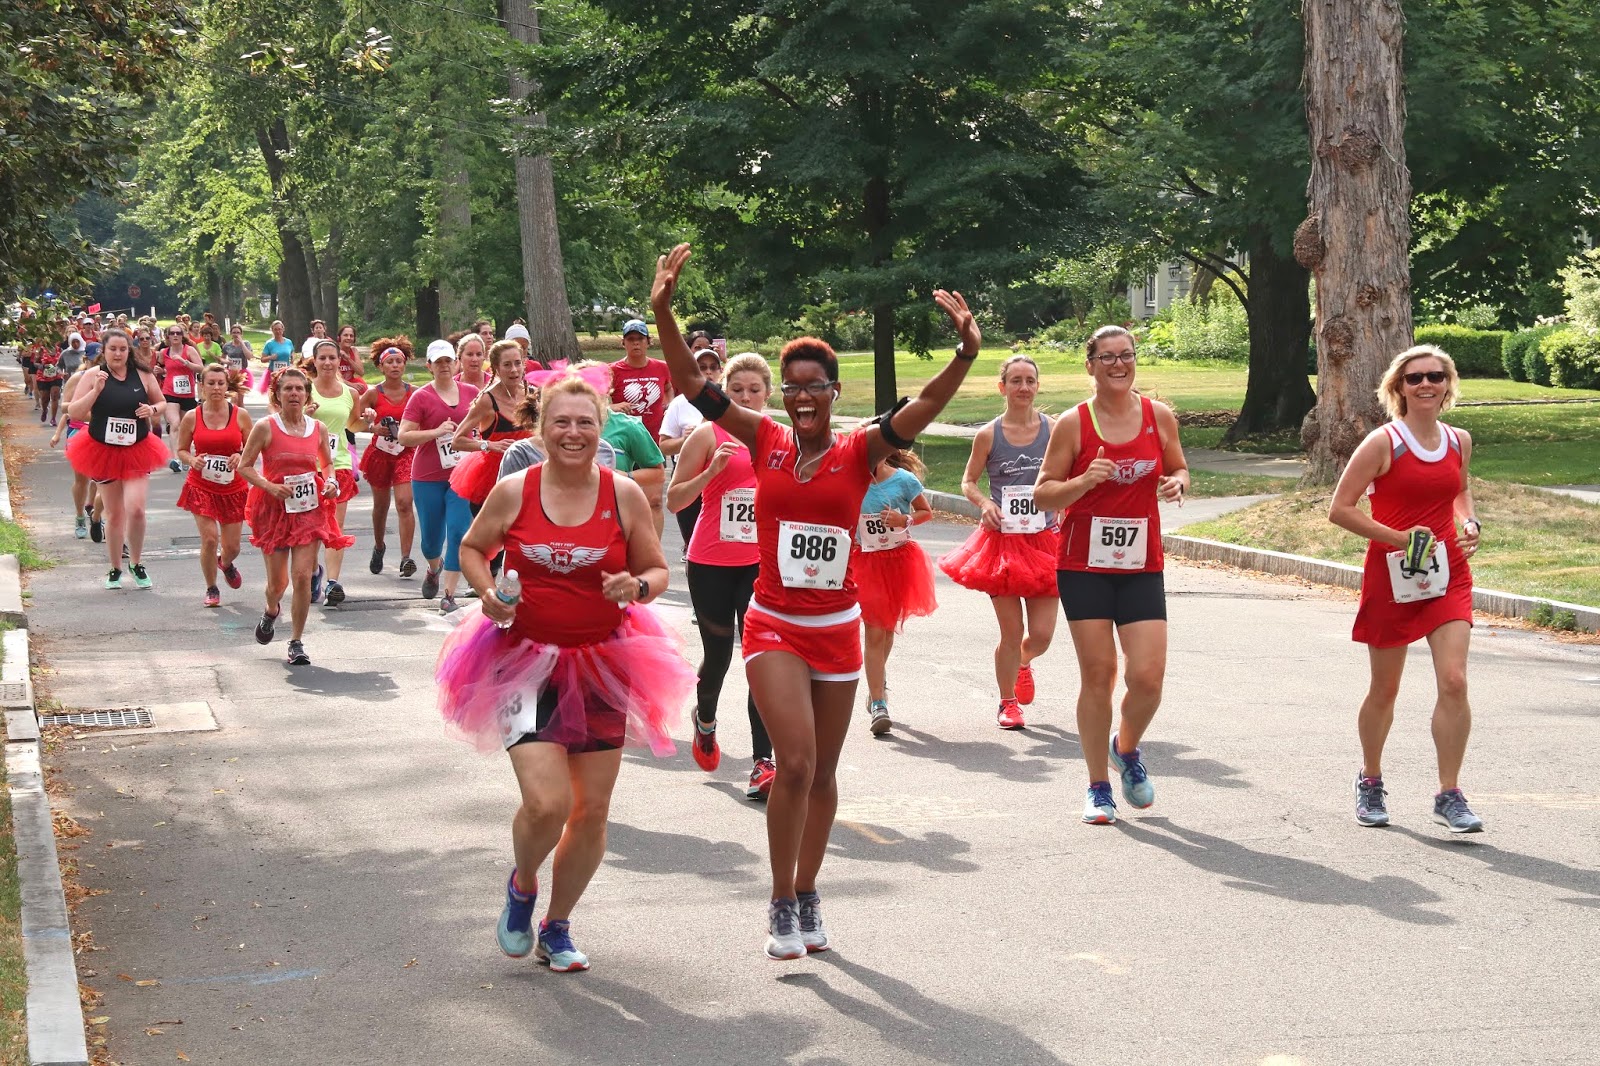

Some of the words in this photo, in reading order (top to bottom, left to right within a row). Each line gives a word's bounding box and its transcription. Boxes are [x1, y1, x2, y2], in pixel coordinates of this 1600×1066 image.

[110, 422, 135, 434] 1560
[441, 442, 460, 456] 12
[1009, 498, 1039, 515] 890
[865, 519, 895, 535] 89
[1101, 525, 1139, 547] 597
[790, 533, 838, 562] 986
